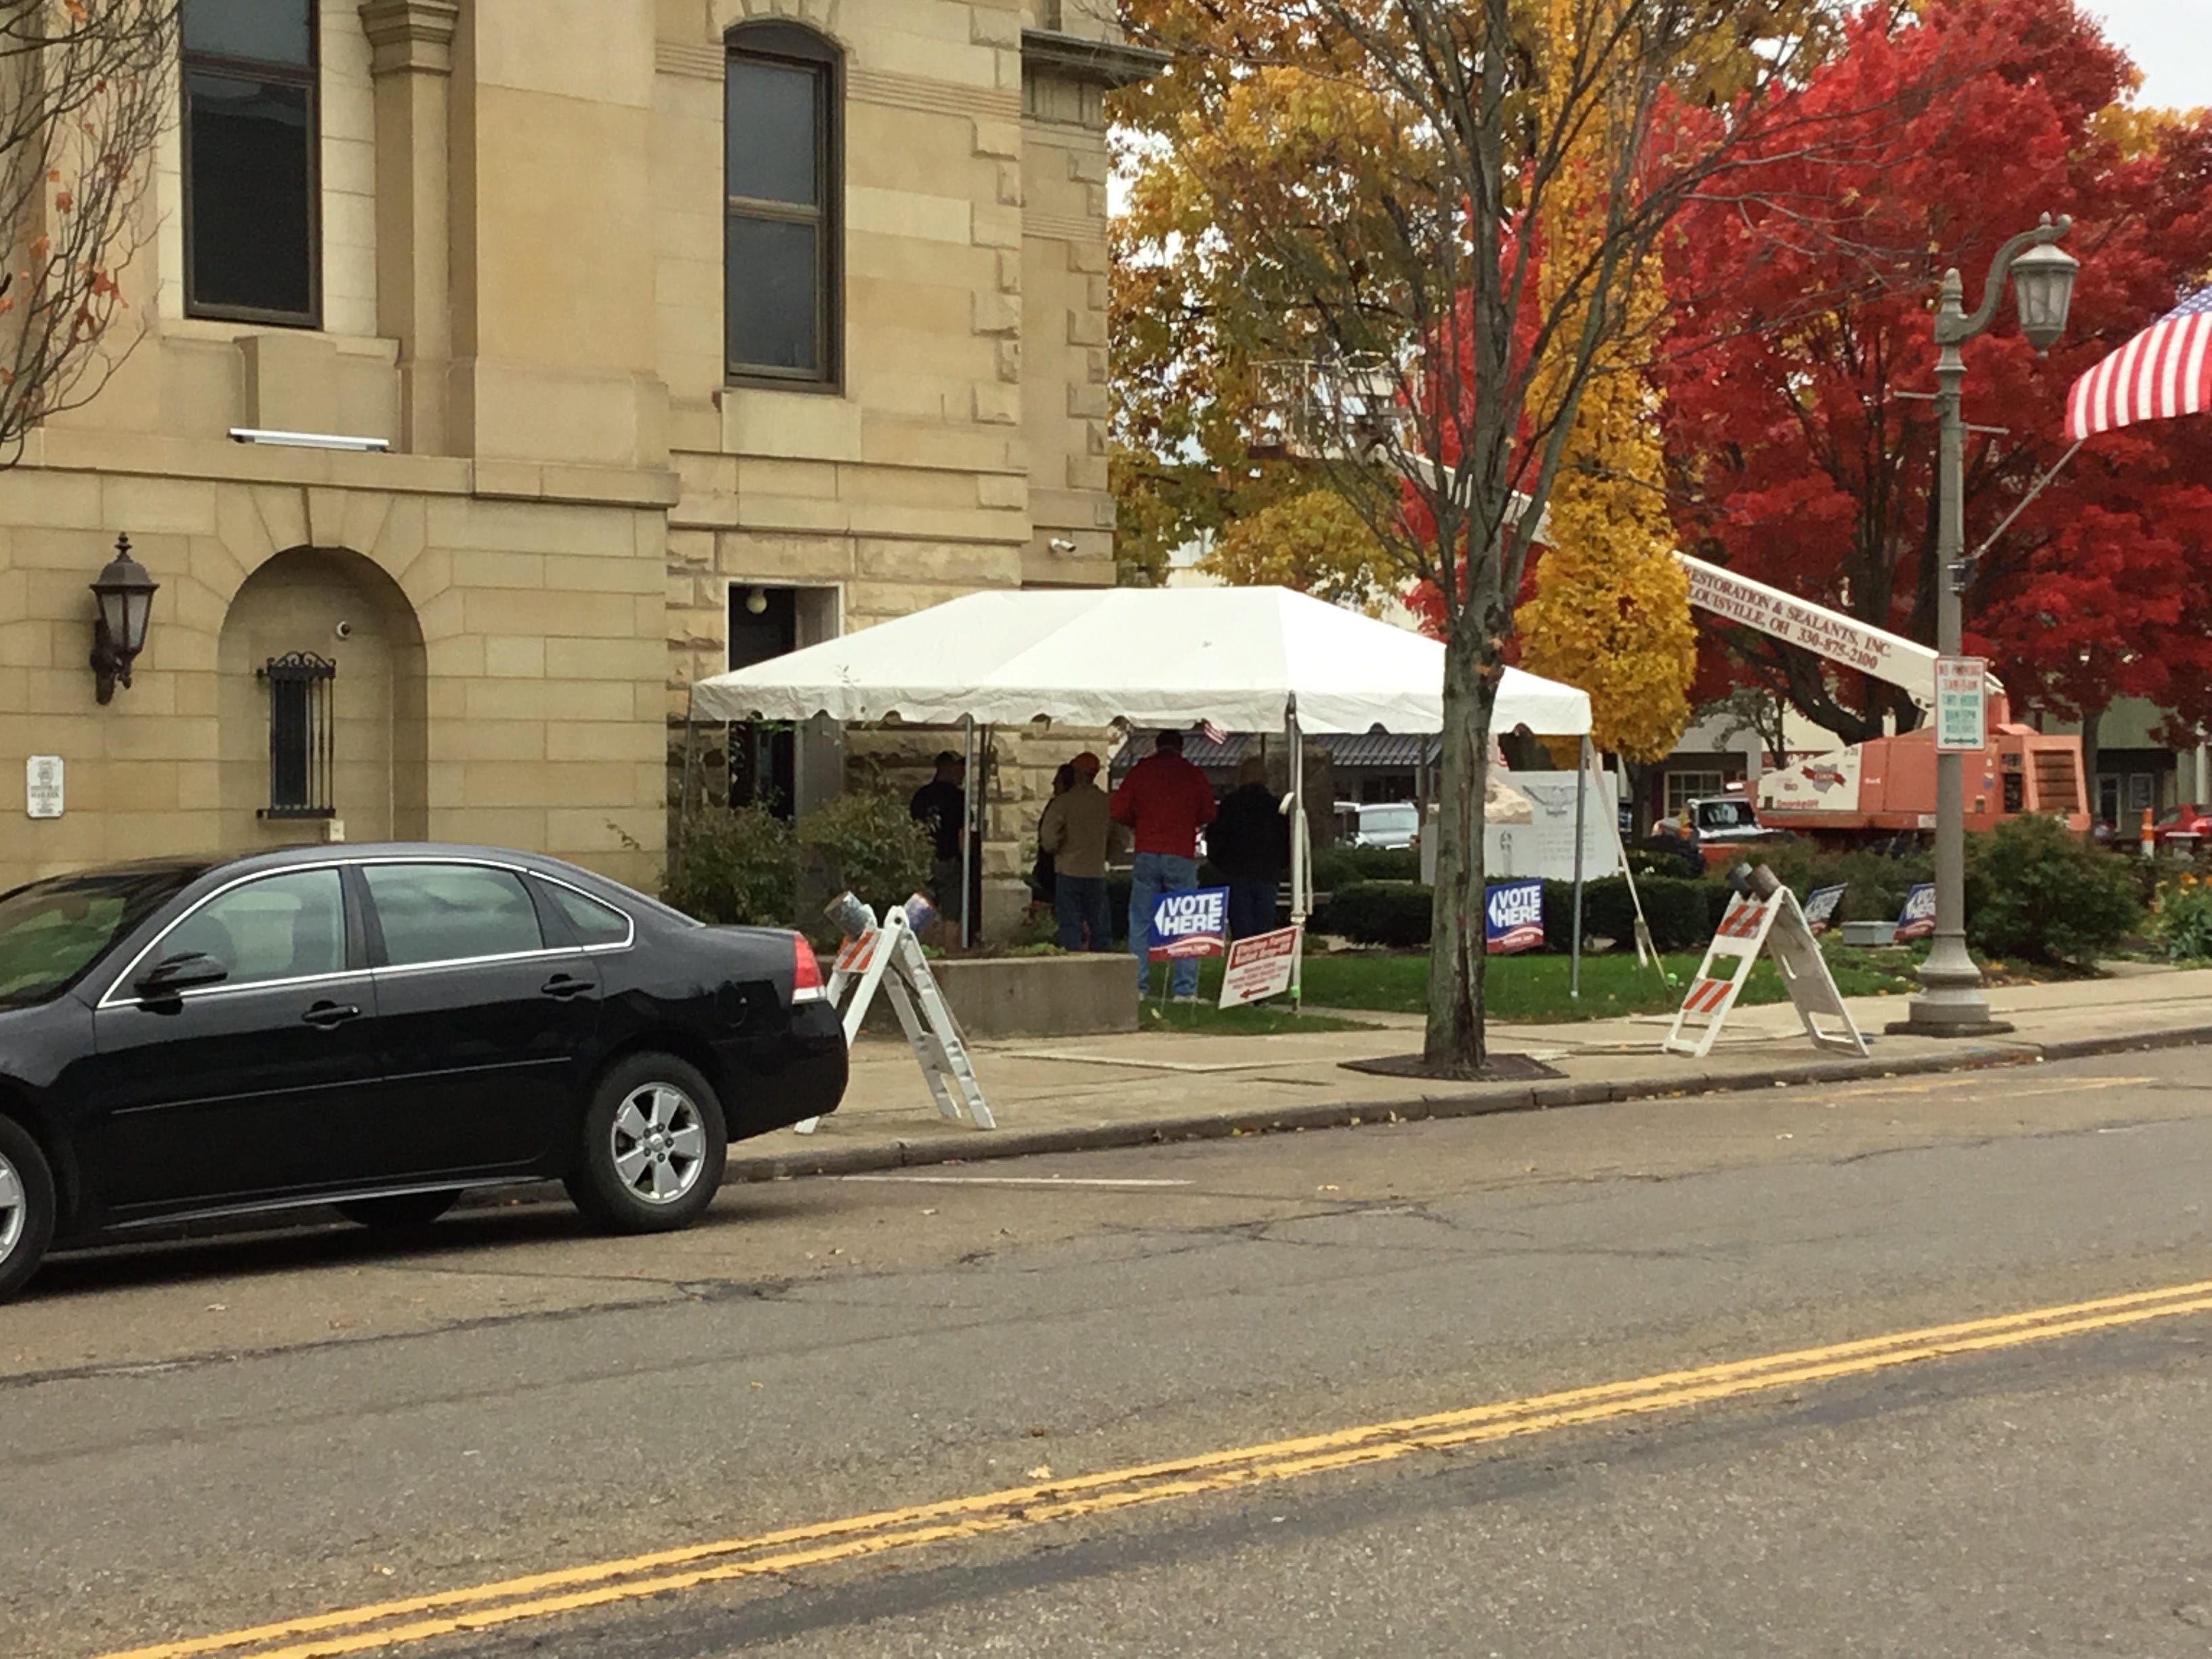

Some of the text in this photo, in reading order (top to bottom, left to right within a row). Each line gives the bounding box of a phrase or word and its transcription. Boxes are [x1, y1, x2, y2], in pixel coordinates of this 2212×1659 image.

[1769, 617, 1790, 635] OH
[1786, 607, 1858, 646] SEALANTS,
[1864, 637, 1891, 657] INC.
[1166, 893, 1223, 916] VOTE
[1497, 884, 1541, 909] VOTE
[1163, 912, 1222, 937] HERE
[1497, 904, 1541, 928] HERE
